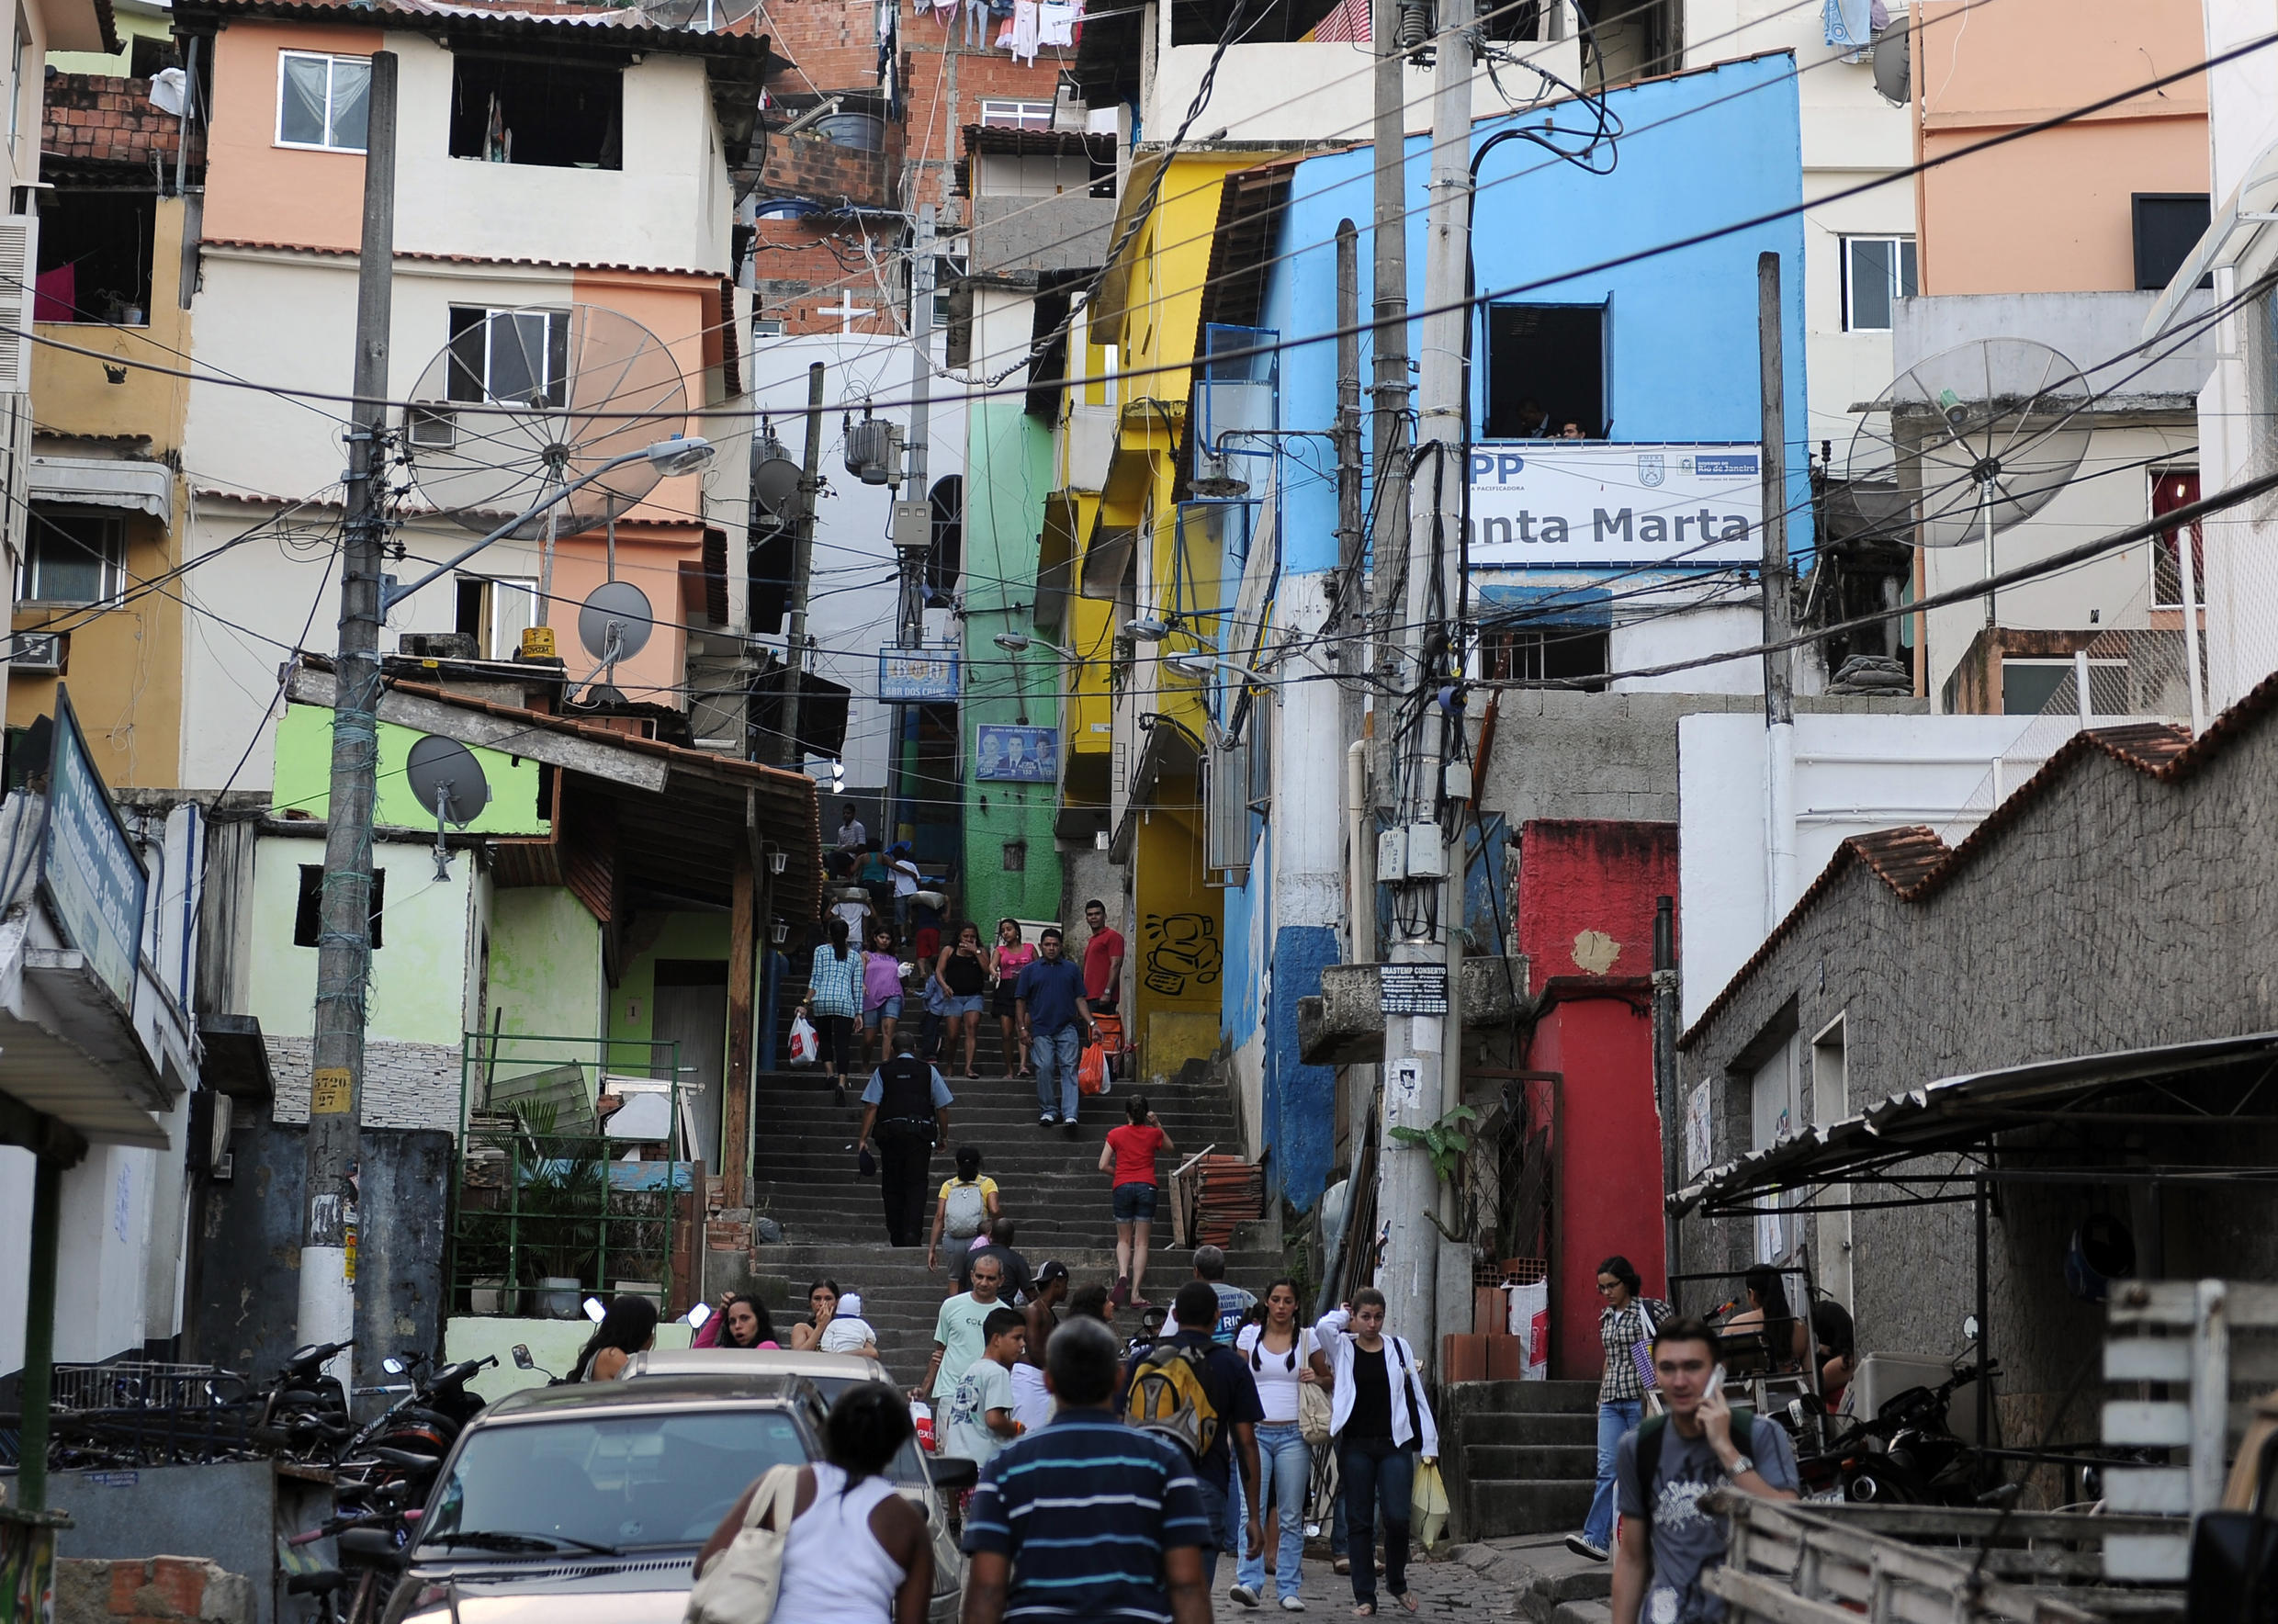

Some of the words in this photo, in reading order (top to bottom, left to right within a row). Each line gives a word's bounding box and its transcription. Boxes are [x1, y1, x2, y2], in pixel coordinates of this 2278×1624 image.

[1469, 510, 1569, 544] nta
[1593, 507, 1750, 542] Marta
[314, 1077, 346, 1088] 5720
[319, 1096, 334, 1106] 27
